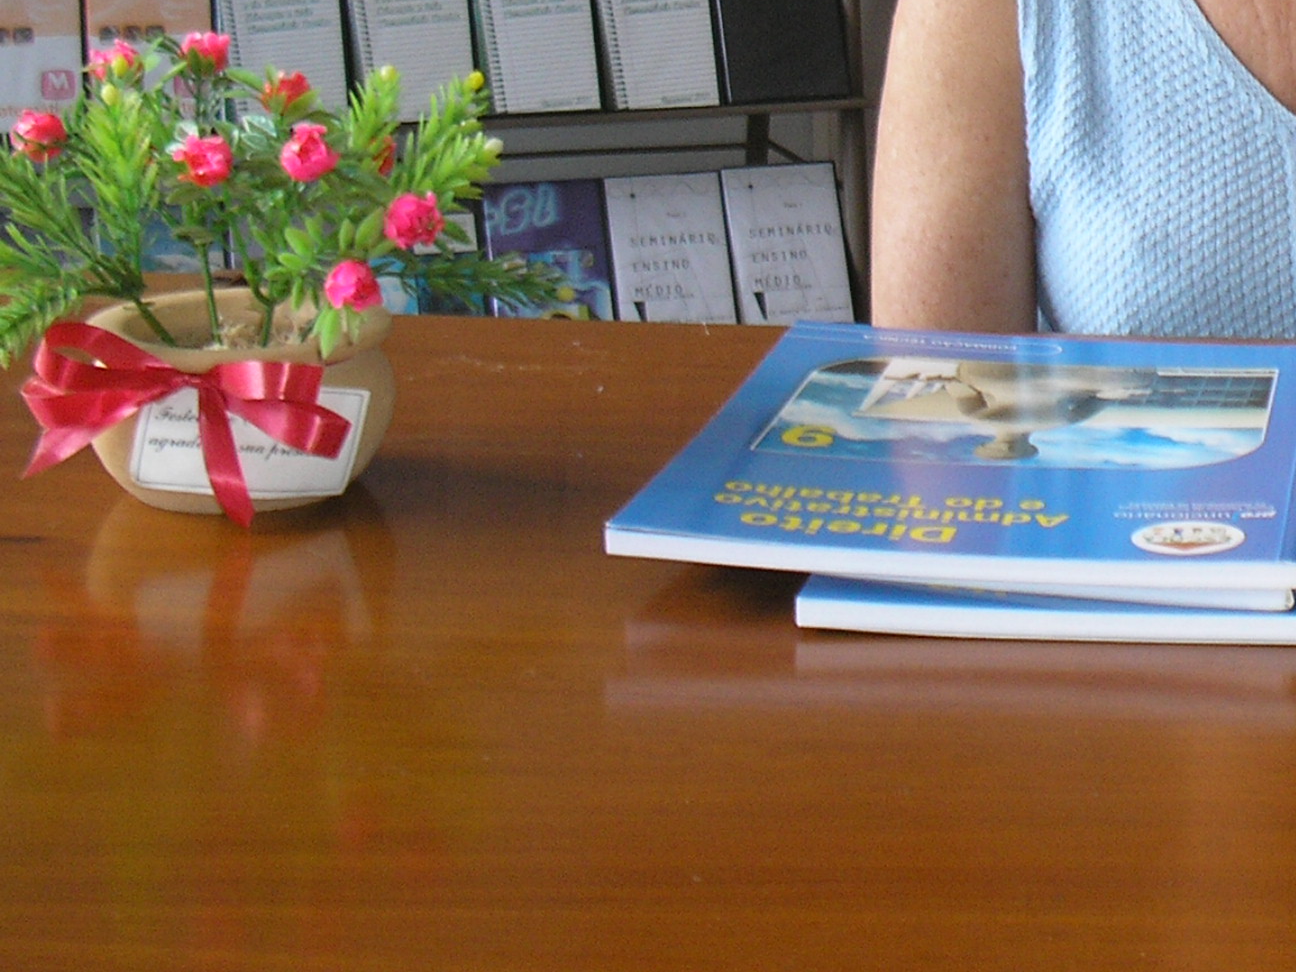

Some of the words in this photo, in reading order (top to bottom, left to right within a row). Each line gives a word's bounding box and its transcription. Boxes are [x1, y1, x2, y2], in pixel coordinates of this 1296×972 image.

[749, 221, 833, 239] SEMINÁRIO
[630, 232, 716, 248] SEMINÁRIO
[752, 249, 808, 264] ENSINO
[632, 259, 690, 273] ENSINO
[635, 281, 684, 297] MÉDIO
[754, 274, 802, 290] MÉDIO
[780, 427, 838, 448] 9
[725, 480, 921, 508] Trabalho
[713, 492, 1070, 528] Administrativo
[945, 496, 1003, 510] do
[1018, 498, 1046, 510] e
[740, 510, 957, 544] Direito
